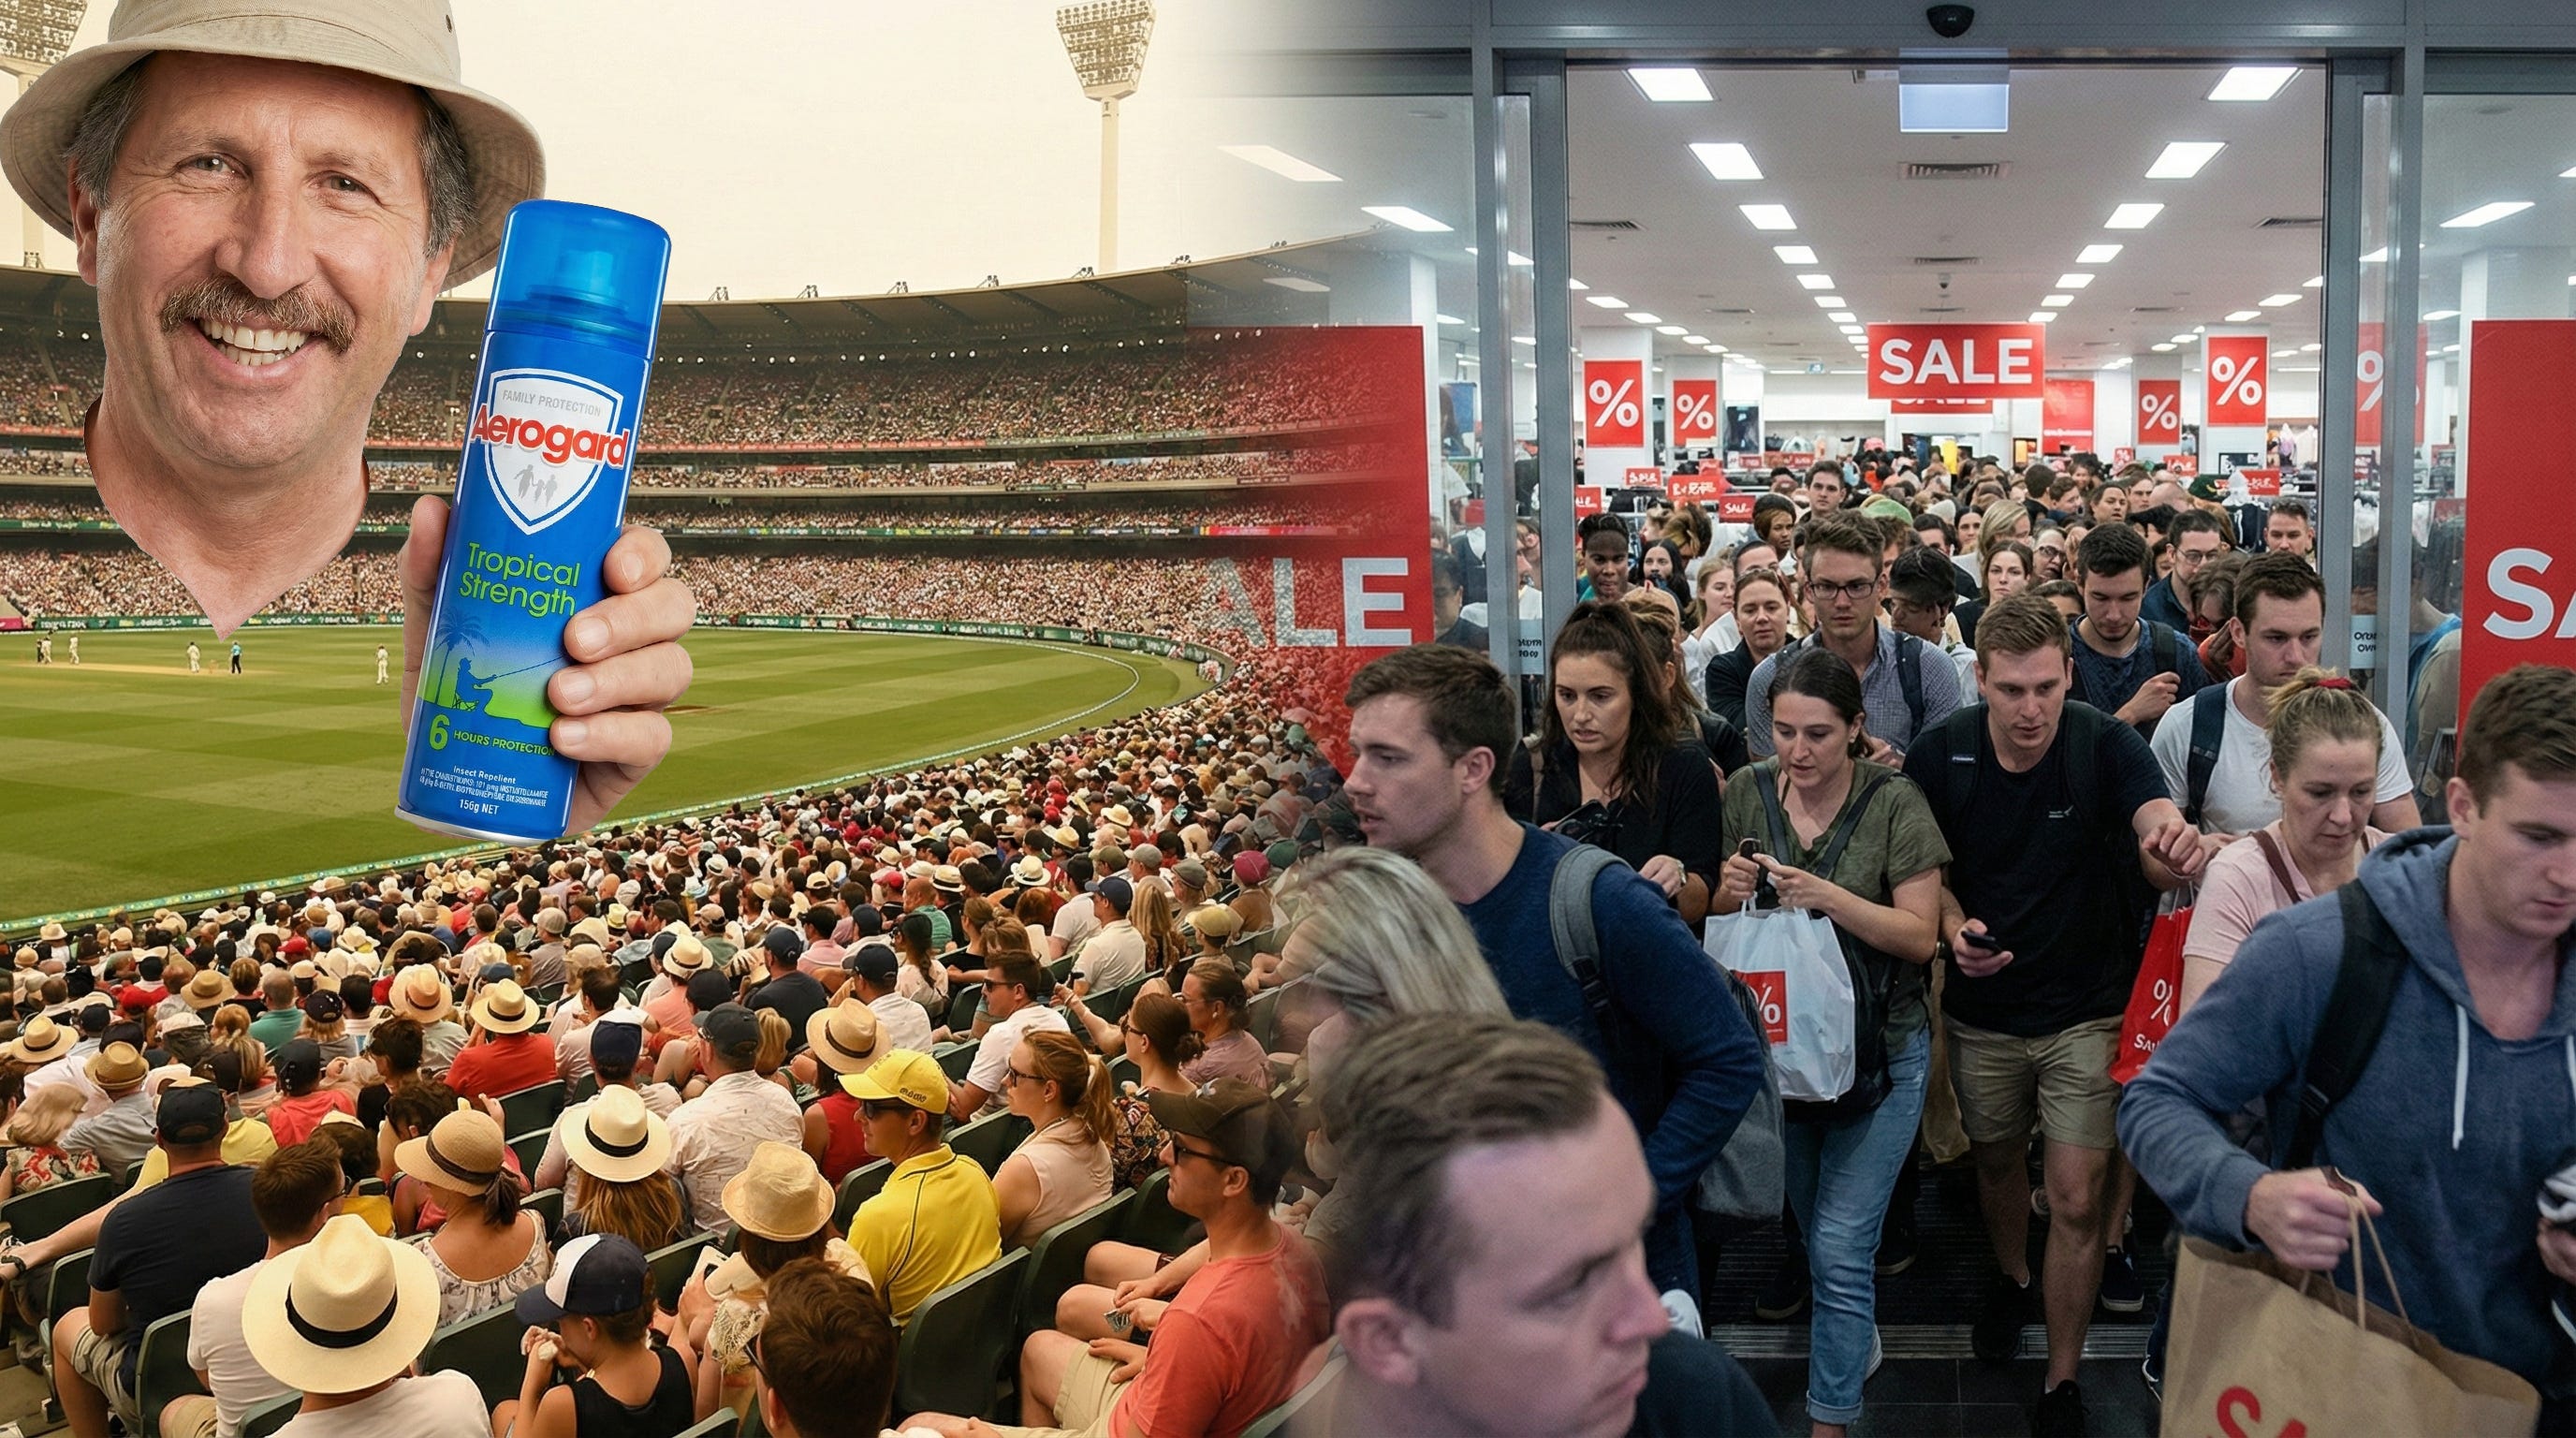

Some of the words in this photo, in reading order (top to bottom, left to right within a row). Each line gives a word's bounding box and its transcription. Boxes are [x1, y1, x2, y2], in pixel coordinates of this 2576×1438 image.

[1880, 338, 2033, 386] SALE
[2211, 356, 2263, 406] %
[502, 389, 536, 405] FAMILY
[538, 394, 601, 417] PROTECTION
[1588, 378, 1640, 428] %
[1676, 393, 1715, 431] %
[2141, 393, 2178, 430] %
[470, 404, 629, 465] Aerogard
[469, 541, 581, 587] Tropical
[459, 570, 577, 619] Strength
[2482, 547, 2576, 640] S
[429, 713, 450, 751] 6
[453, 729, 490, 747] HOURS
[491, 737, 555, 756] PROTECTION
[453, 765, 476, 777] Insect
[459, 799, 479, 814] 156g
[481, 802, 500, 815] NET
